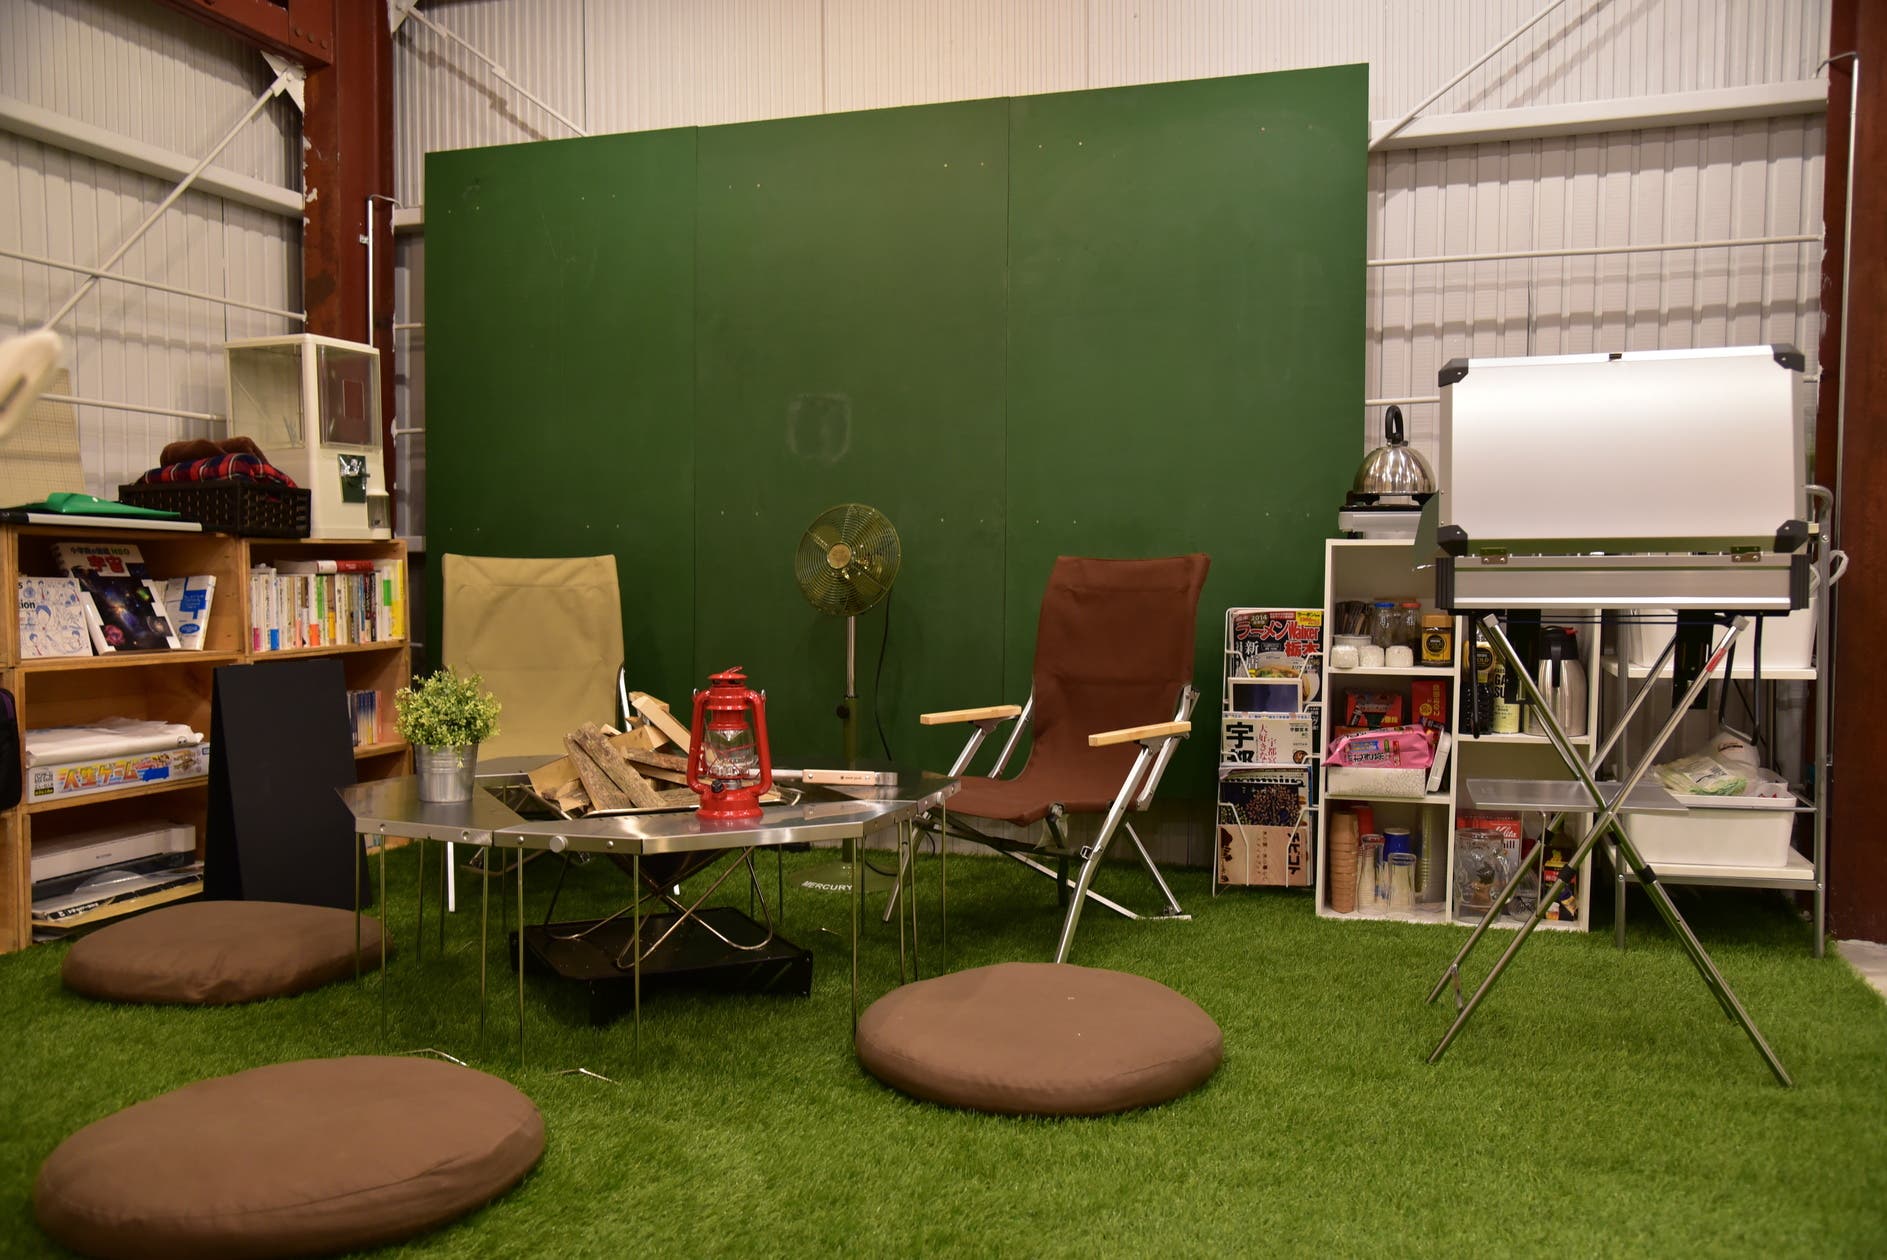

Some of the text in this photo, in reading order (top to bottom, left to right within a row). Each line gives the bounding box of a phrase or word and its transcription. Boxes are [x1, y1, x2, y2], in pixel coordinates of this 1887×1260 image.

[87, 555, 125, 573] 宇宙
[62, 760, 138, 790] 人生ゲーム
[801, 880, 853, 891] MERCURY
